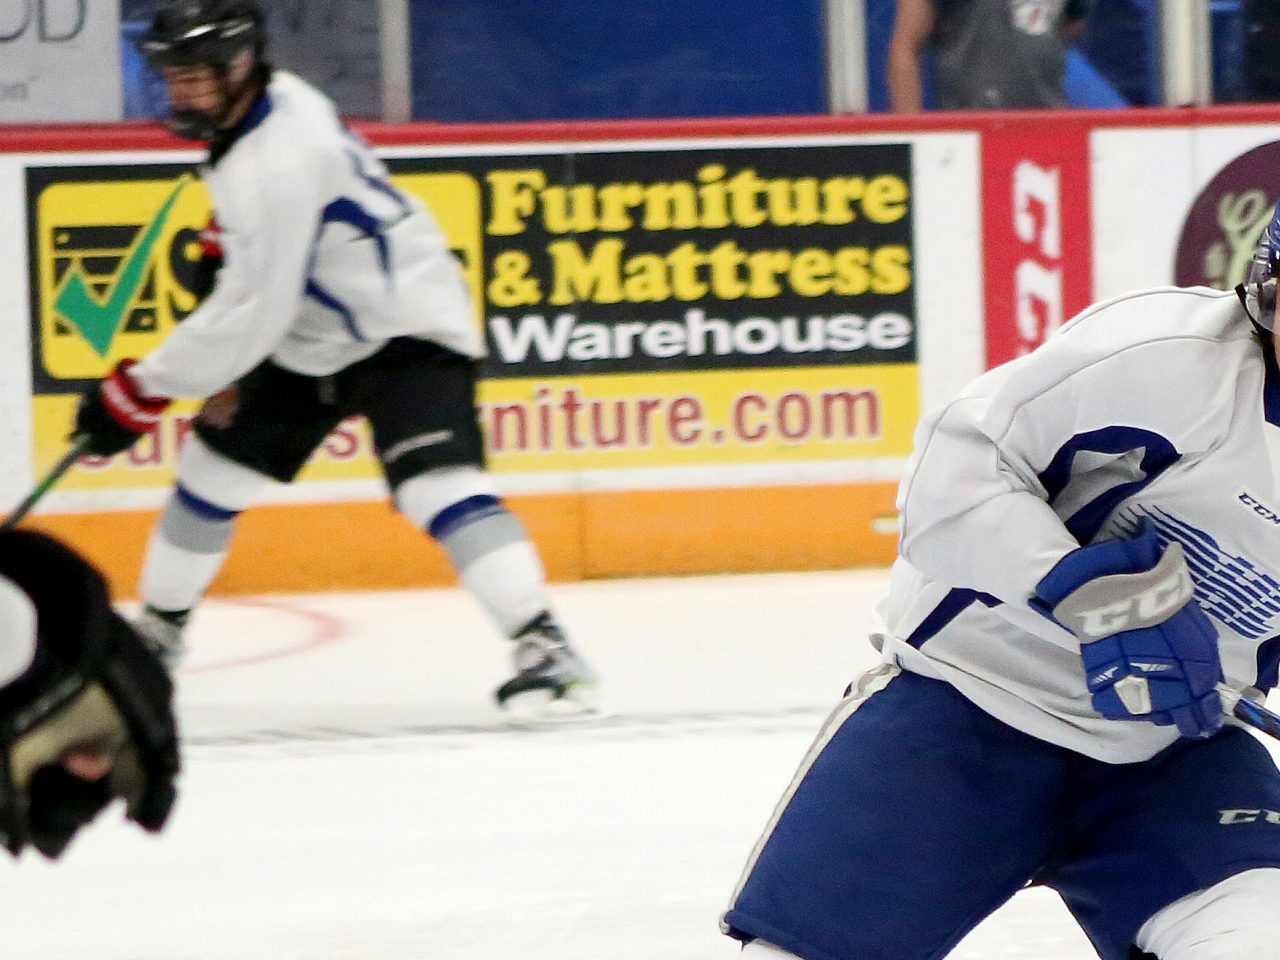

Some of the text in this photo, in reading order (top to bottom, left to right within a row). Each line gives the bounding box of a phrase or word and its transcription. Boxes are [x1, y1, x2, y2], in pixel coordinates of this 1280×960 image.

[486, 163, 908, 236] Furniture
[487, 237, 912, 307] & Mattress
[1013, 161, 1062, 357] CC
[488, 308, 913, 364] Warehouse
[1075, 564, 1195, 637] CC
